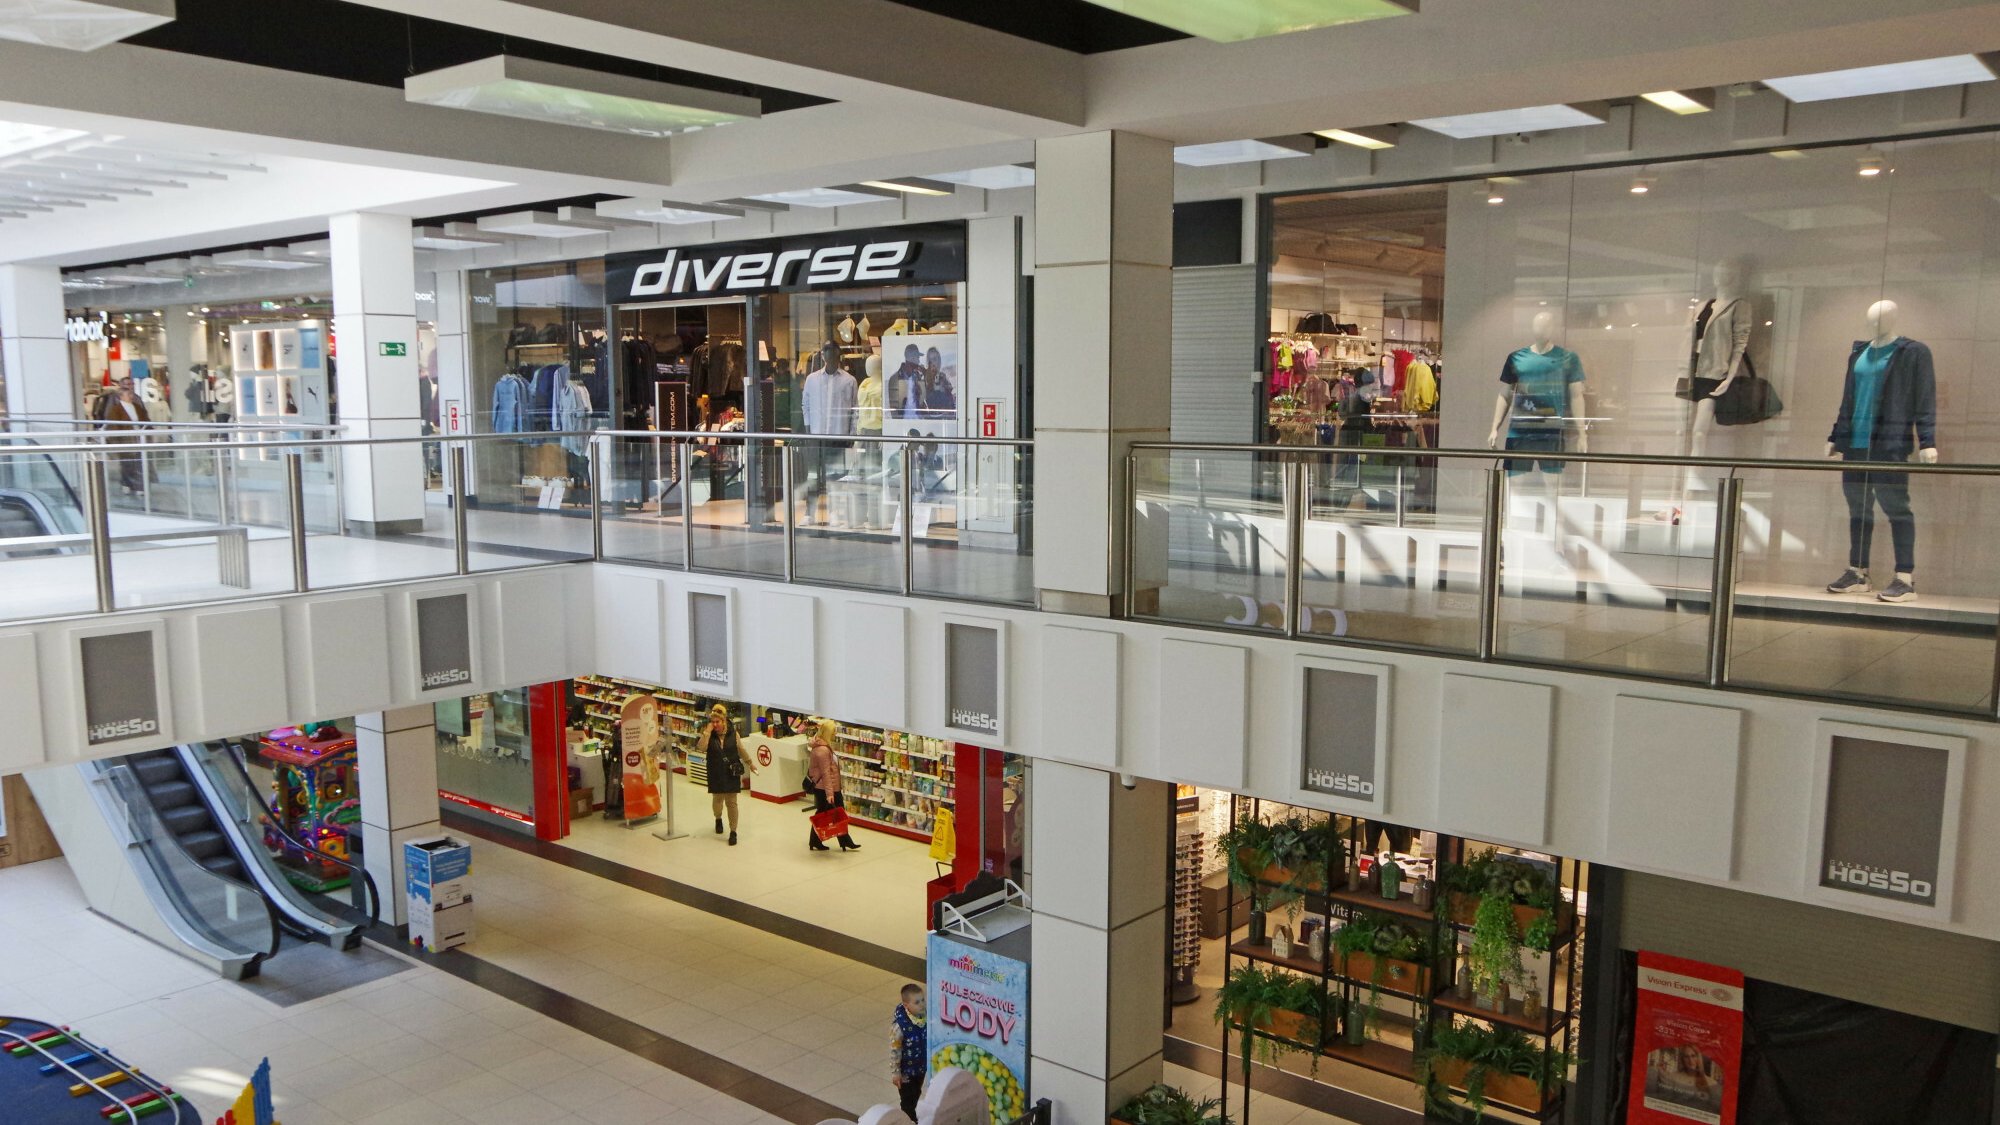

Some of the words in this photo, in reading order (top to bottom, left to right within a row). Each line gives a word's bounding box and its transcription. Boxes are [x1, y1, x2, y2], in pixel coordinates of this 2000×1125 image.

[630, 240, 910, 296] diverse
[669, 391, 677, 483] DIVERSESYTEM.COM
[1829, 859, 1889, 875] GALERIA
[940, 980, 1016, 1014] KULECZKOWE
[1647, 975, 1672, 987] Vision
[1674, 981, 1707, 995] Express
[940, 993, 1016, 1045] LODY
